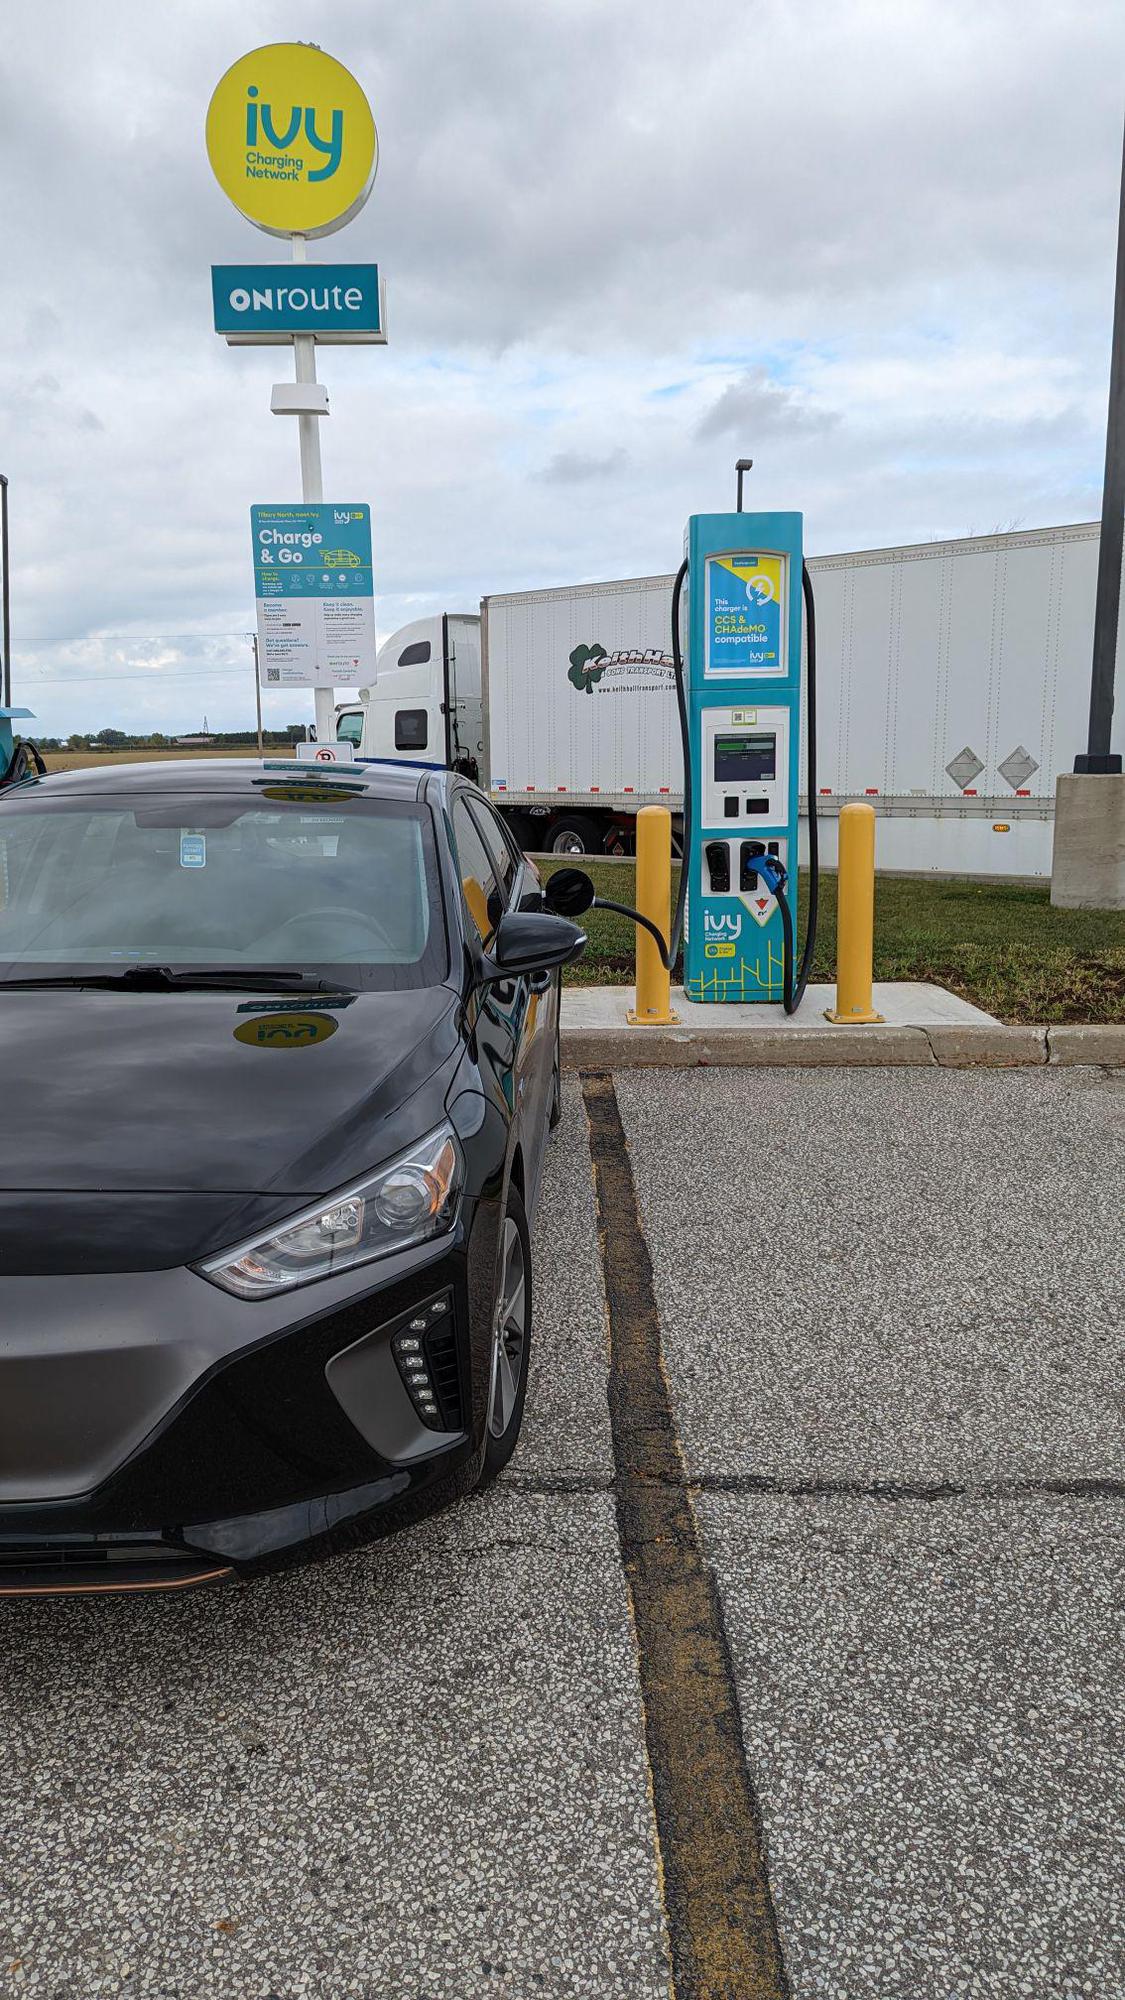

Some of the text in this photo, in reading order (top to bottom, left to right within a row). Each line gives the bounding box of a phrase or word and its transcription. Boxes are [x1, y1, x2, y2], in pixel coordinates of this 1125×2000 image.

[246, 85, 344, 182] ivy
[246, 151, 304, 171] Charging
[246, 168, 300, 182] Network
[333, 509, 350, 524] ivy
[259, 528, 323, 548] Charge
[261, 548, 303, 564] & Go
[714, 615, 746, 625] CCS &
[714, 624, 766, 634] CHAdeMO
[714, 633, 768, 645] compatible
[749, 650, 764, 662] ivy
[626, 666, 666, 679] TRANSPORT
[704, 909, 742, 941] ivy
